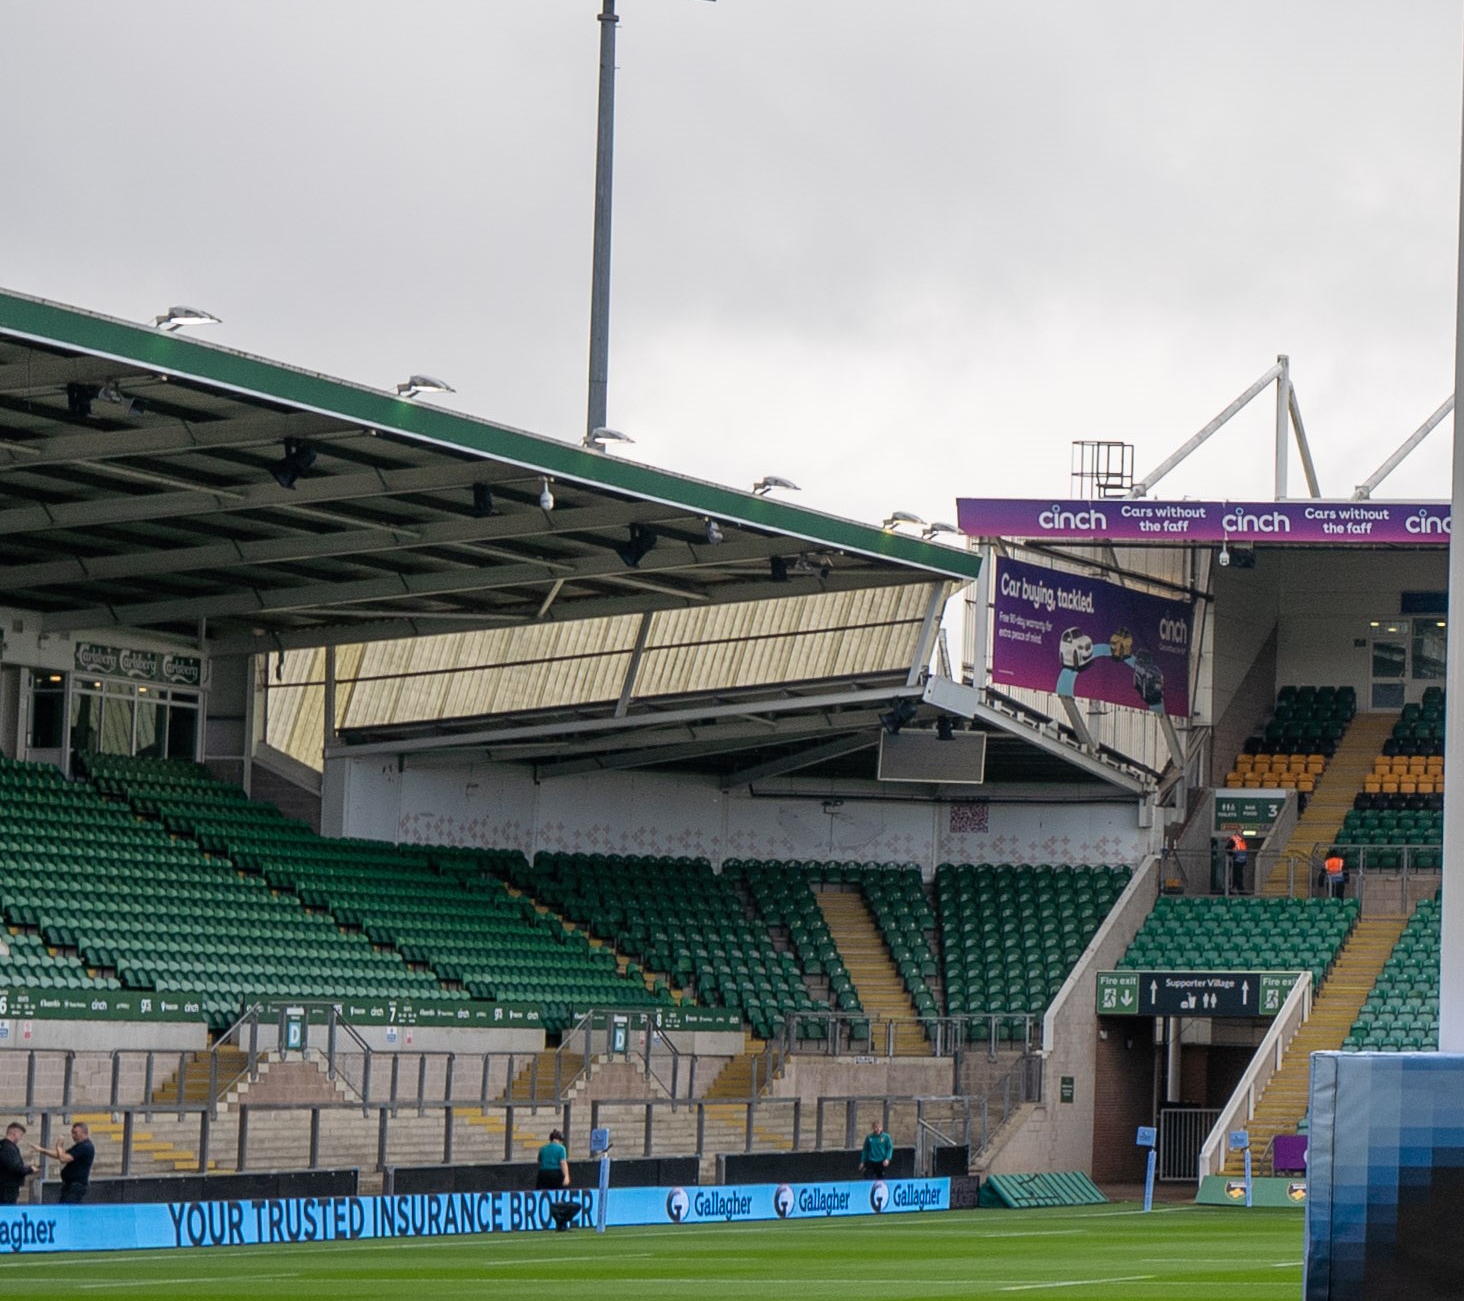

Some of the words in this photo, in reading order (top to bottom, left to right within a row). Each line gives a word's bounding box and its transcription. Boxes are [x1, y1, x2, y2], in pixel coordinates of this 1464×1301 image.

[1039, 505, 1106, 530] cinch
[1122, 505, 1153, 517] Cars
[1156, 505, 1206, 517] without
[1140, 519, 1160, 531] the
[1164, 519, 1188, 531] faff
[1222, 507, 1290, 533] cinch
[1001, 572, 1021, 598] Car
[1022, 577, 1056, 612] buying,
[1057, 587, 1095, 614] tackled.
[1159, 610, 1187, 644] cinch
[76, 642, 116, 673] Carlsberg
[119, 648, 157, 678] Carlsberg
[162, 654, 198, 683] Carlsberg
[1268, 804, 1278, 817] 3
[1100, 977, 1118, 985] Fire
[1119, 977, 1136, 986] exit
[1165, 979, 1206, 989] Supporter
[1207, 979, 1235, 989] Village
[390, 1007, 396, 1022] 7
[694, 1186, 752, 1222] Gallagher
[798, 1186, 851, 1217] Gallagher
[892, 1184, 941, 1212] Gallagher
[167, 1201, 245, 1247] YOUR
[251, 1197, 365, 1244] TRUSTED
[373, 1191, 503, 1240] INSURANCE
